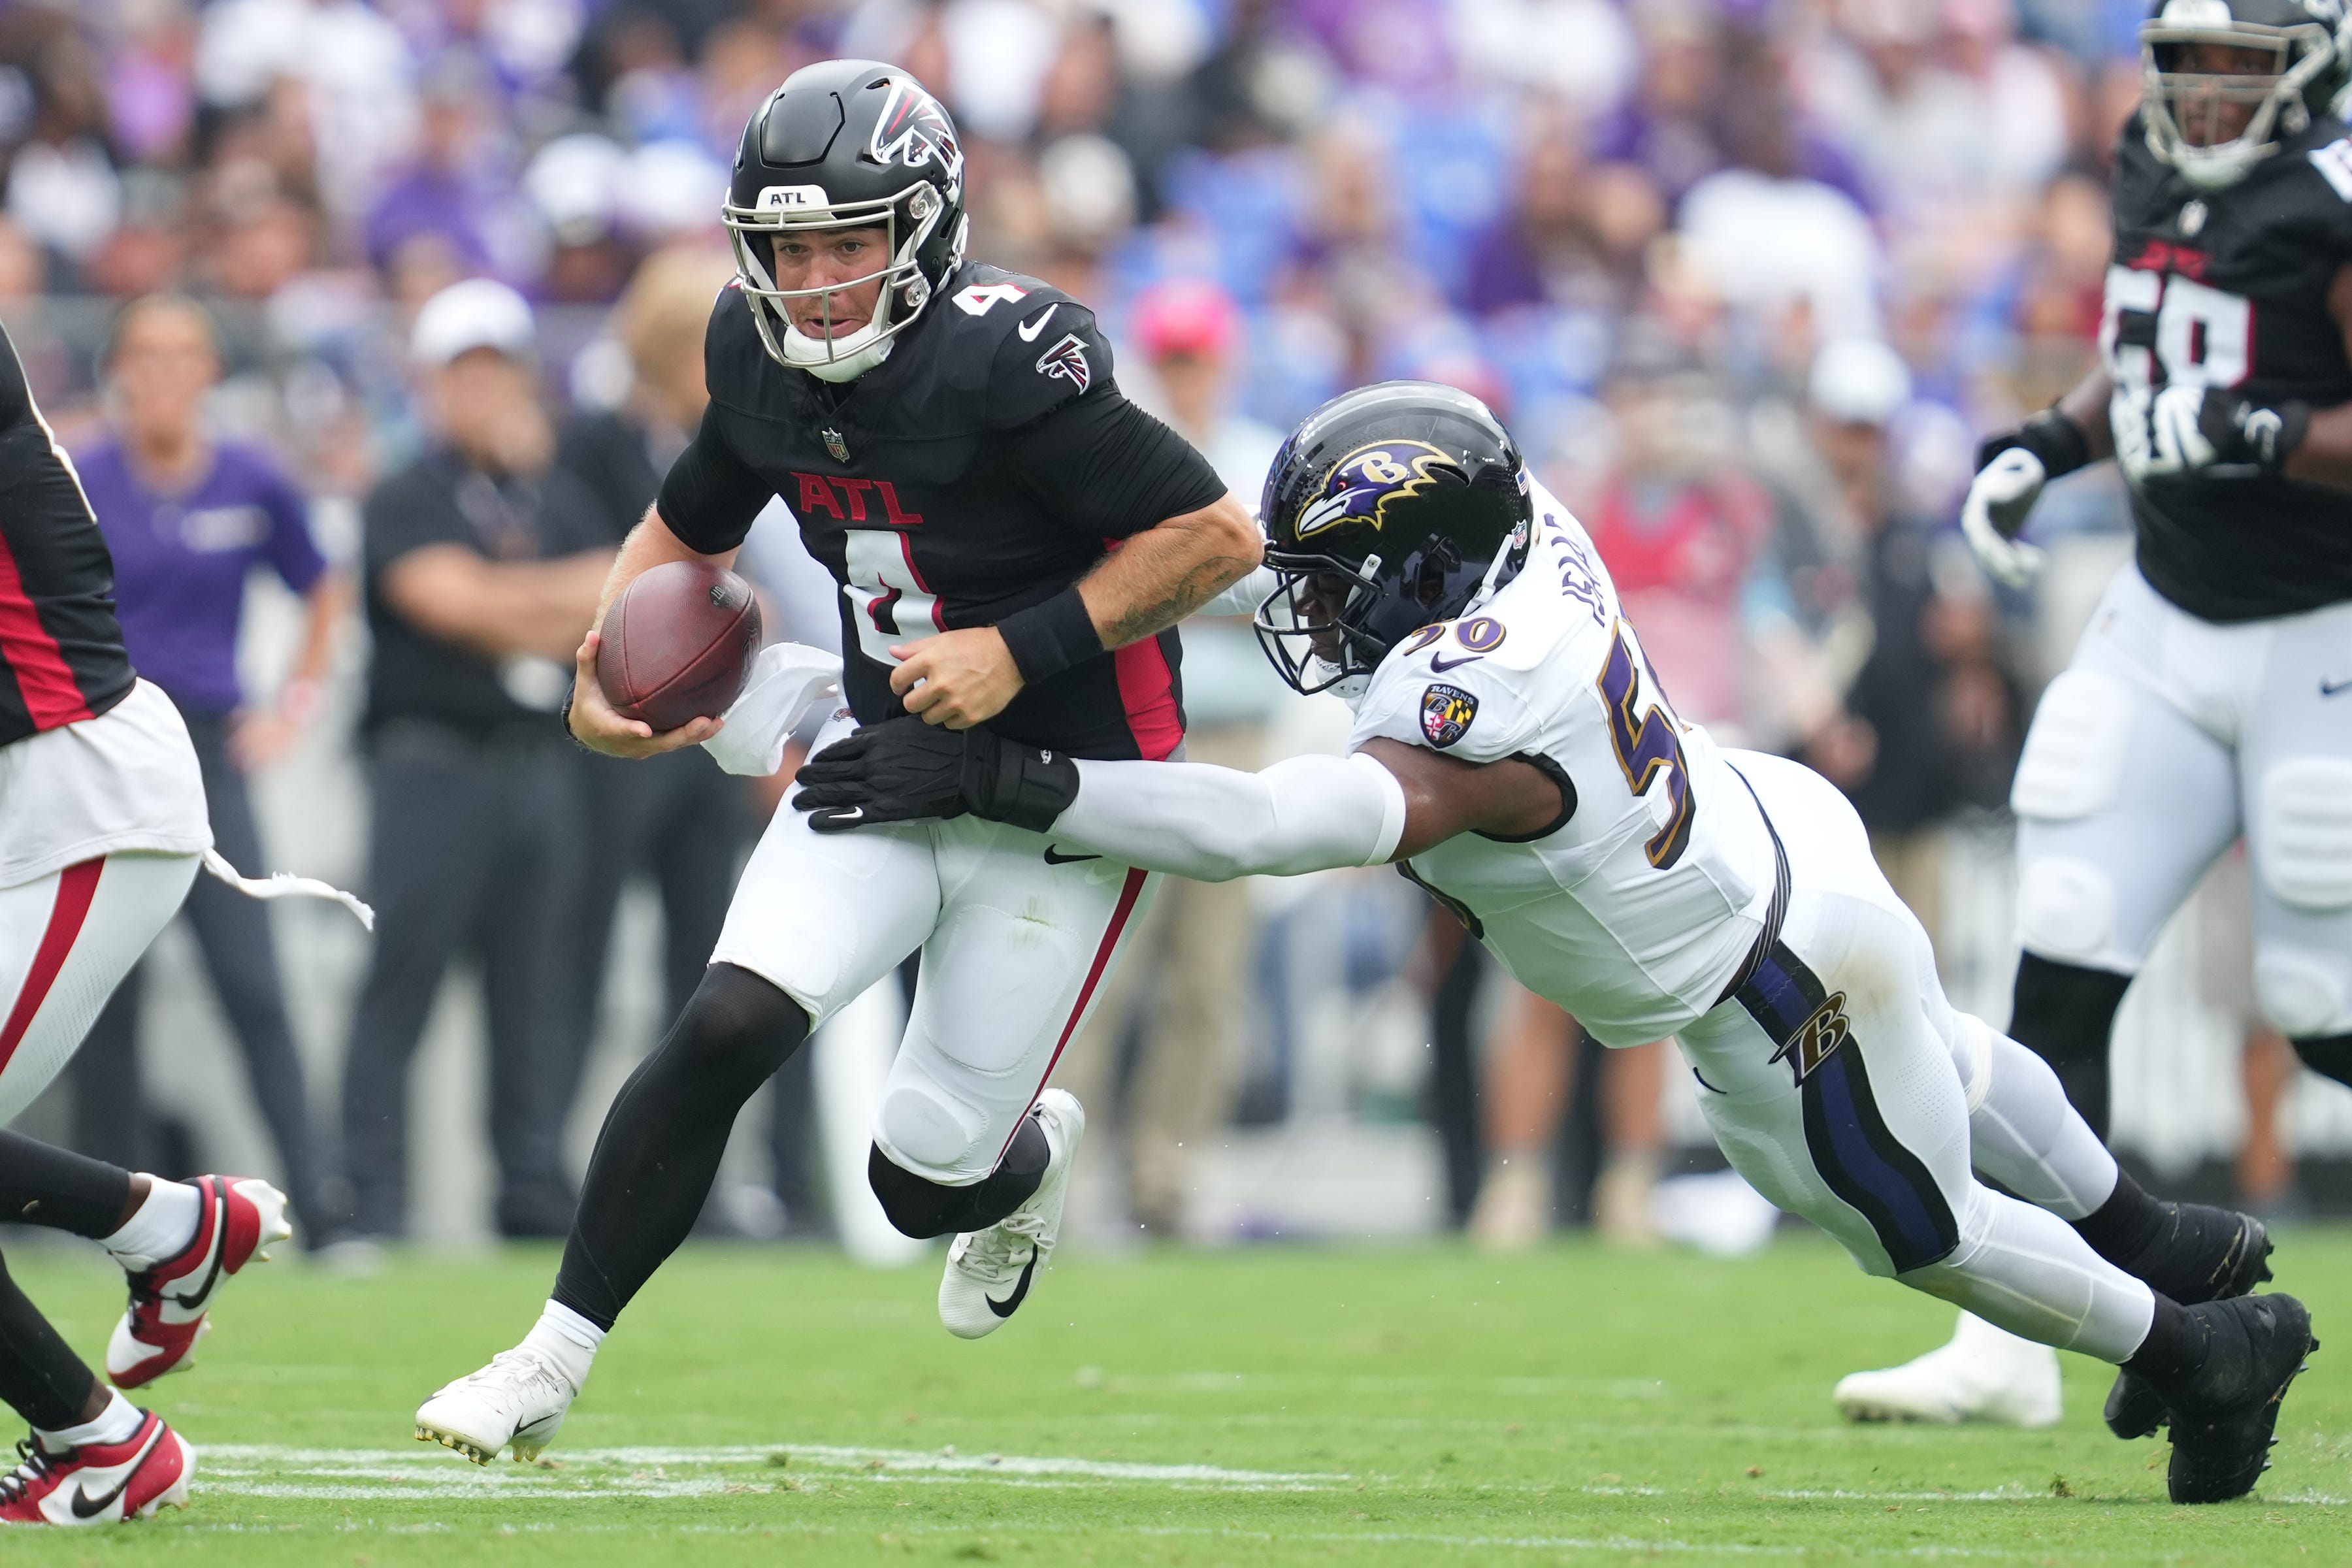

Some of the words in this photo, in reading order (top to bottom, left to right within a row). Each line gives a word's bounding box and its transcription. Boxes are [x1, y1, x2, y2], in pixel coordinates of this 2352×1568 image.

[770, 192, 806, 205] ATL
[951, 282, 1030, 317] 4
[790, 472, 924, 525] ATL
[843, 529, 949, 686] 4
[1431, 685, 1475, 705] RAVENS
[1768, 991, 1850, 1088] B
